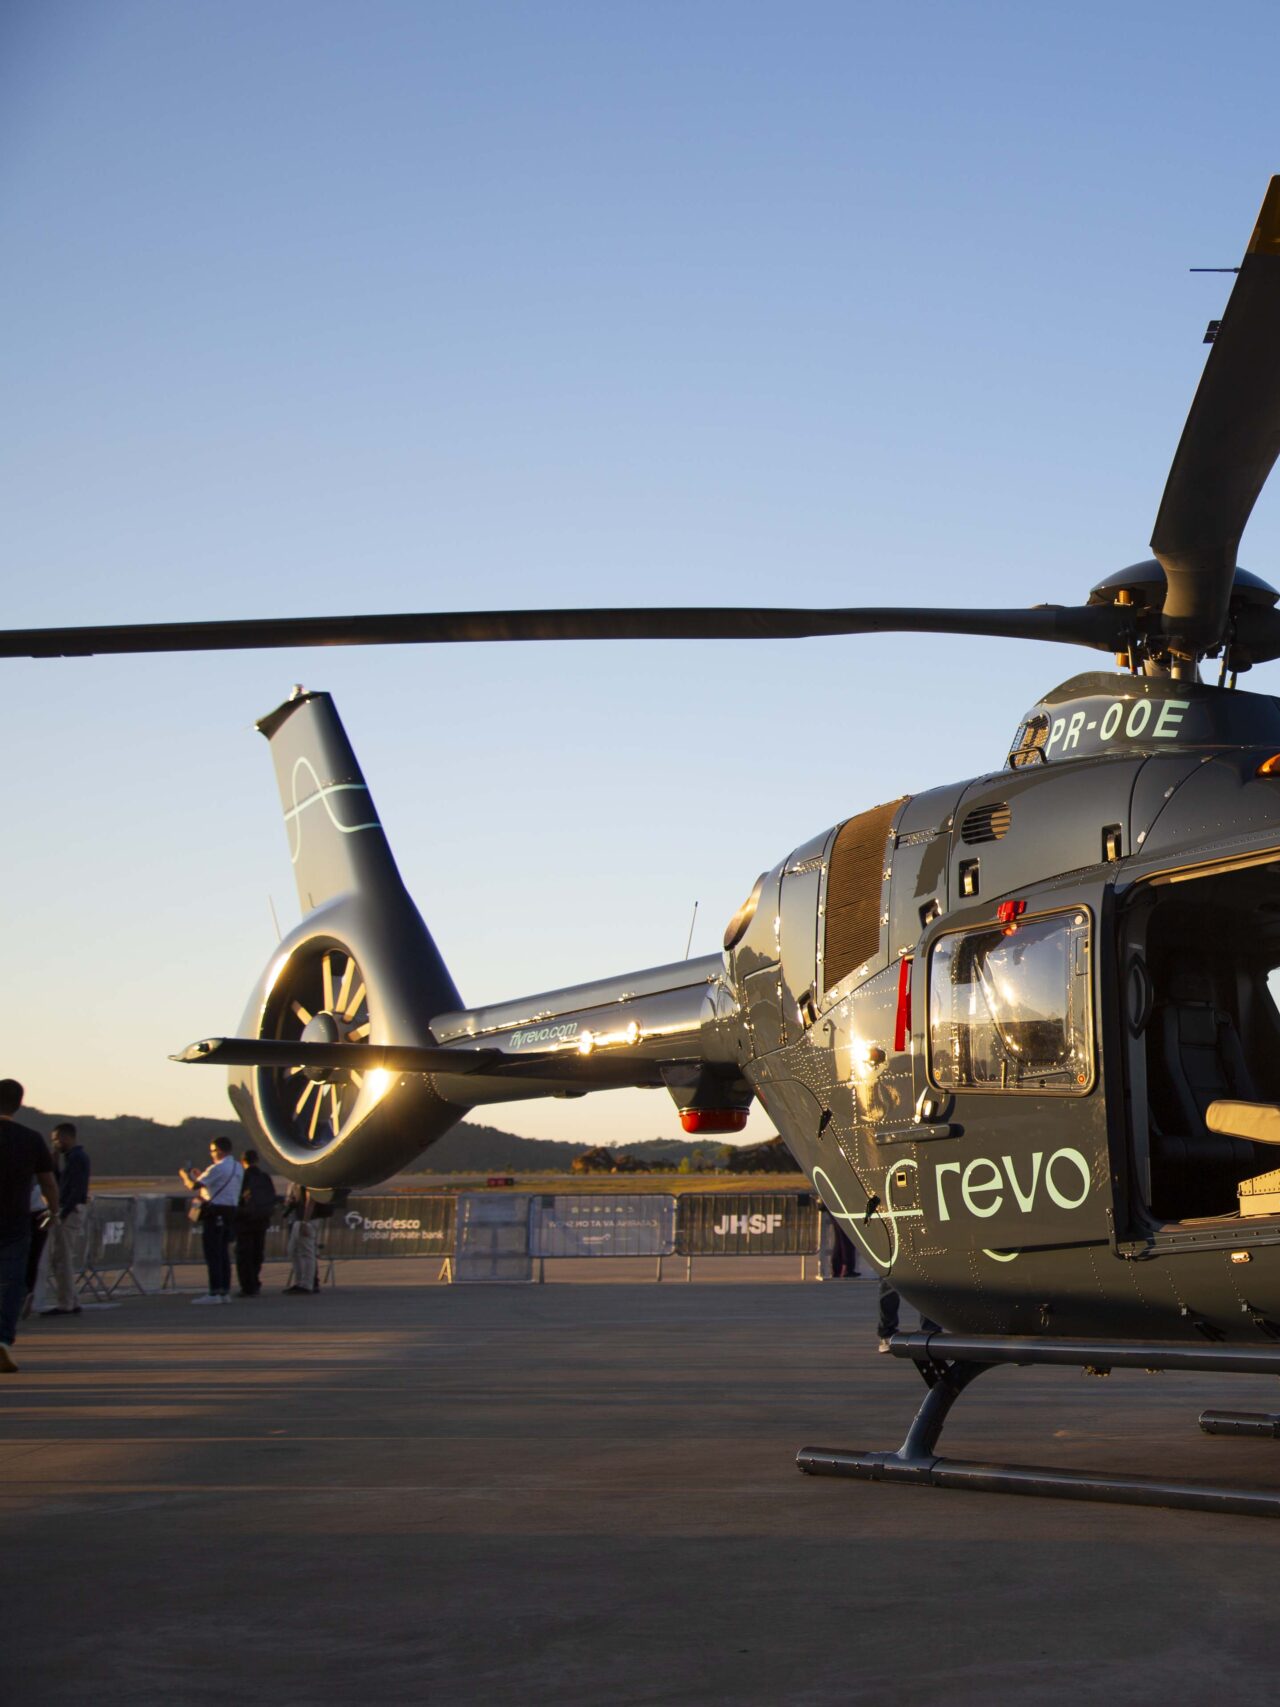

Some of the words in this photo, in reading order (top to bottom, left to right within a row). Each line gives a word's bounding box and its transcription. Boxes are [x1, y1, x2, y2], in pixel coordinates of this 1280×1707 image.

[509, 1022, 578, 1048] flyrevo.com
[935, 1147, 1091, 1221] revo
[363, 1218, 421, 1230] bradesco
[713, 1214, 783, 1235] JHSF
[421, 1230, 444, 1240] bank
